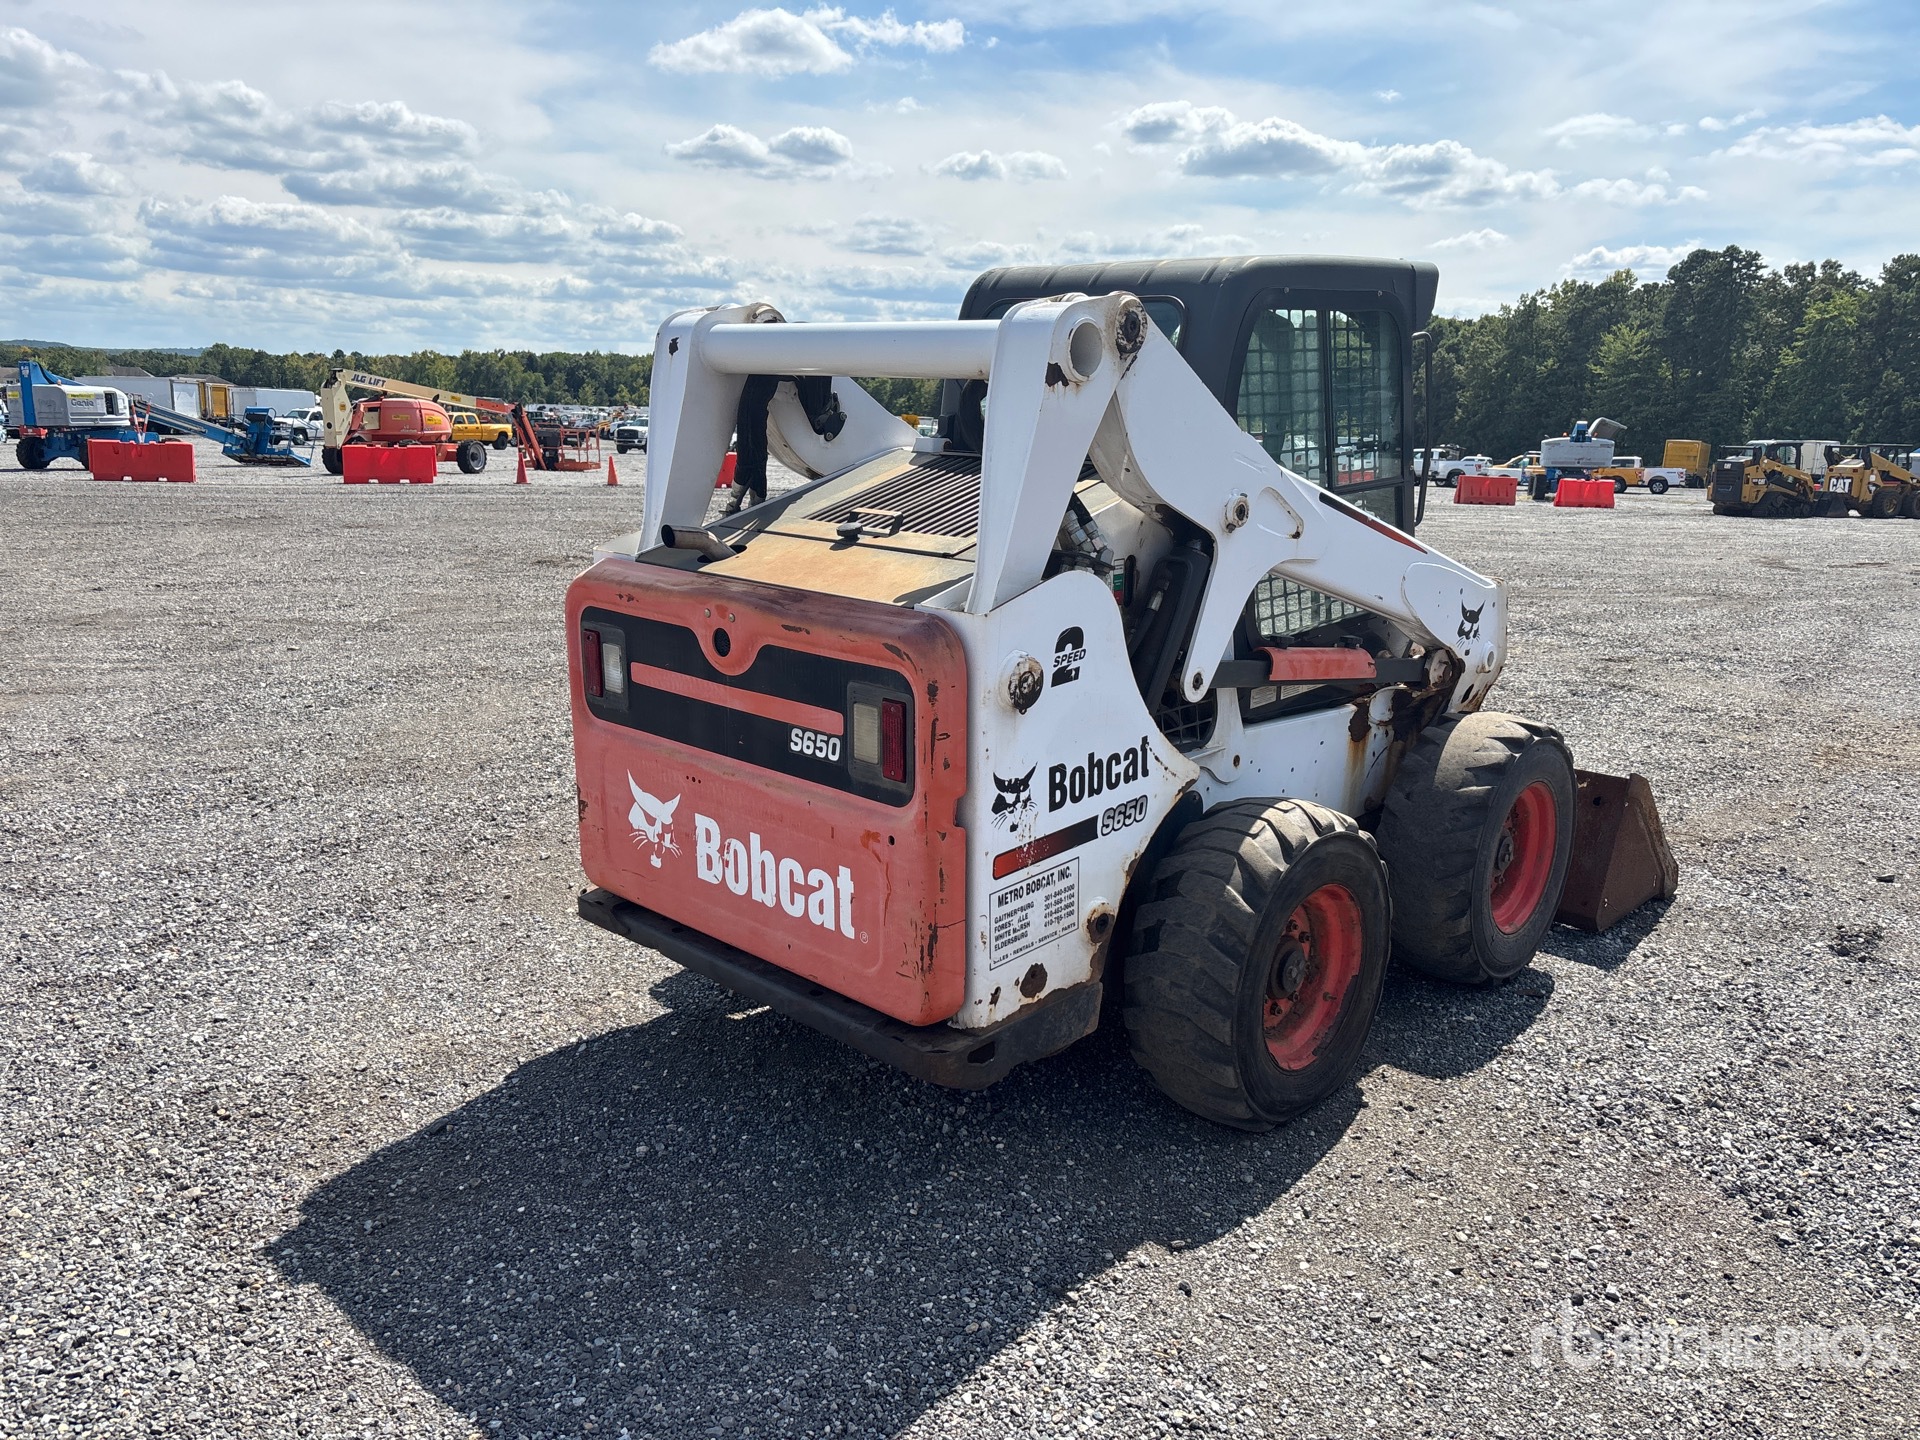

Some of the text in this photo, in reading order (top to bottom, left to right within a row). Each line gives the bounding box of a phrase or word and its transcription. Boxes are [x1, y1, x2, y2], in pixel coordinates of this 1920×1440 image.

[351, 374, 387, 388] JLG LIFT
[71, 399, 95, 407] Genie
[1829, 478, 1852, 494] CAT
[1051, 626, 1085, 688] 2
[1053, 648, 1087, 668] SPEED
[789, 728, 841, 762] S650
[1049, 735, 1149, 813] Bobcat
[1101, 795, 1148, 837] S650
[694, 813, 855, 939] Bobcat
[997, 866, 1072, 908] METRO BOBCAT, INC.
[994, 928, 1012, 943] WHITE
[994, 931, 1028, 951] ELDERSBURG
[1012, 940, 1035, 954] RENTALS
[1038, 931, 1058, 944] SERVICE
[1061, 922, 1076, 932] PARTS
